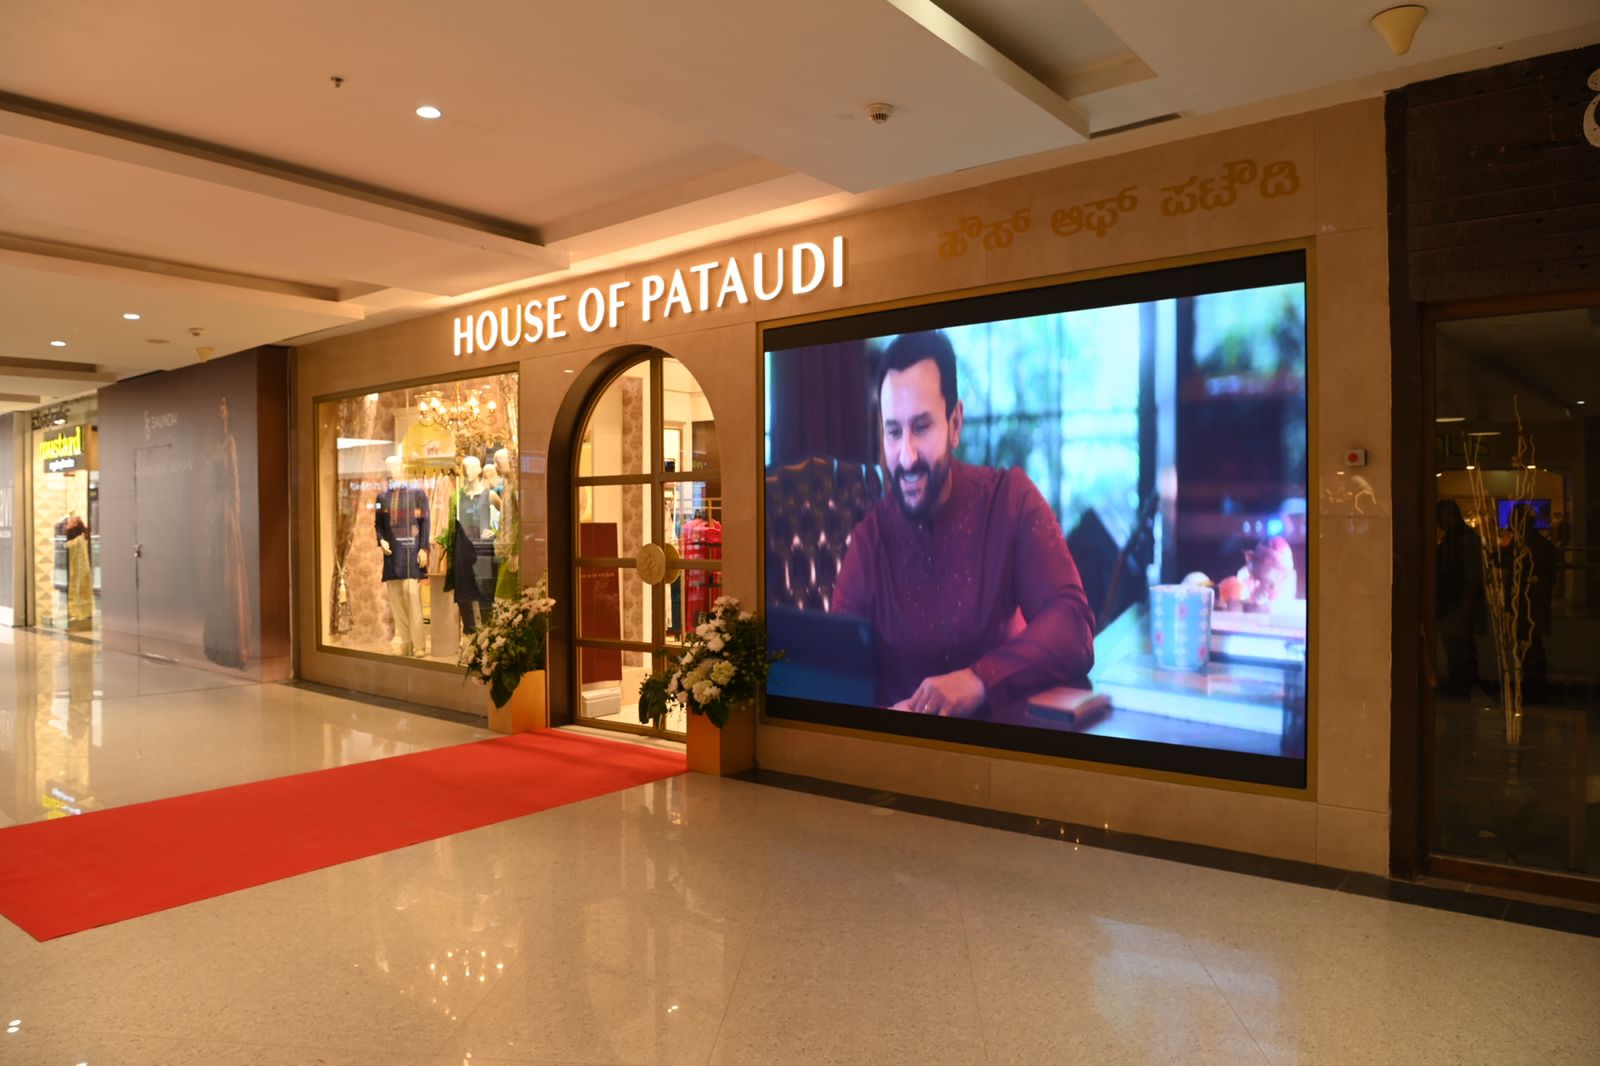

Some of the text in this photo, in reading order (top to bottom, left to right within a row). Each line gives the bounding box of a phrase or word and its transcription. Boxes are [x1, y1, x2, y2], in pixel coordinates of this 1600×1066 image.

[453, 235, 844, 357] HOUSE OF PATAUDI
